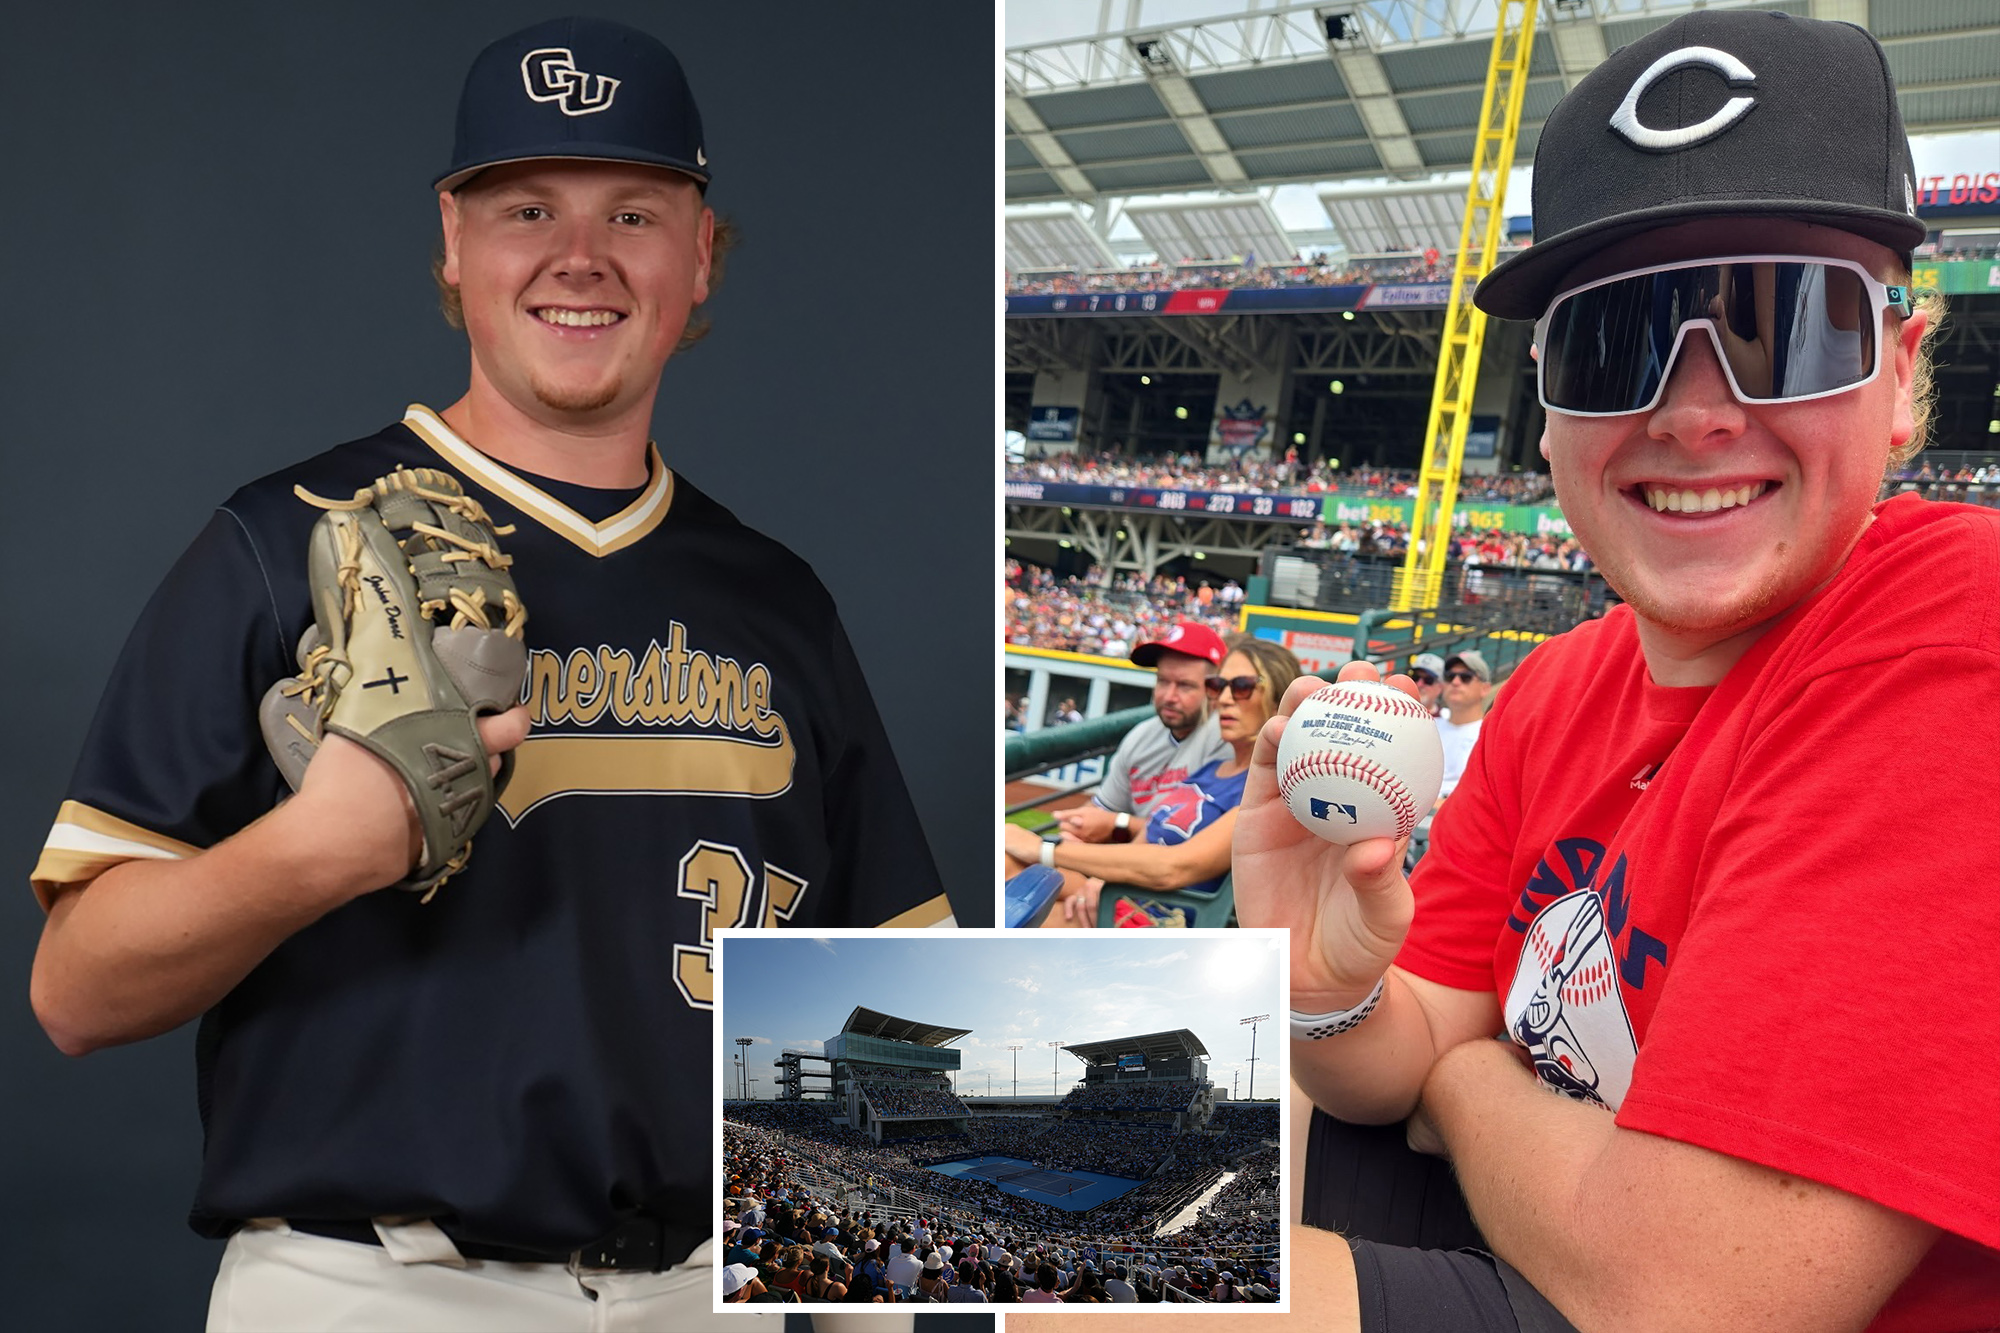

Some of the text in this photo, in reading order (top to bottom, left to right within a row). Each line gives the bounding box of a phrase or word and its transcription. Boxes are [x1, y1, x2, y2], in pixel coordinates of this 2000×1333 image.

[1609, 46, 1757, 150] C
[1336, 503, 1403, 524] bet365
[521, 620, 784, 737] nerstone
[1332, 712, 1362, 724] OFFICIAL
[1301, 719, 1326, 729] MAJOR
[1326, 719, 1354, 732] LEAGUE
[1353, 724, 1393, 743] BASEBALL
